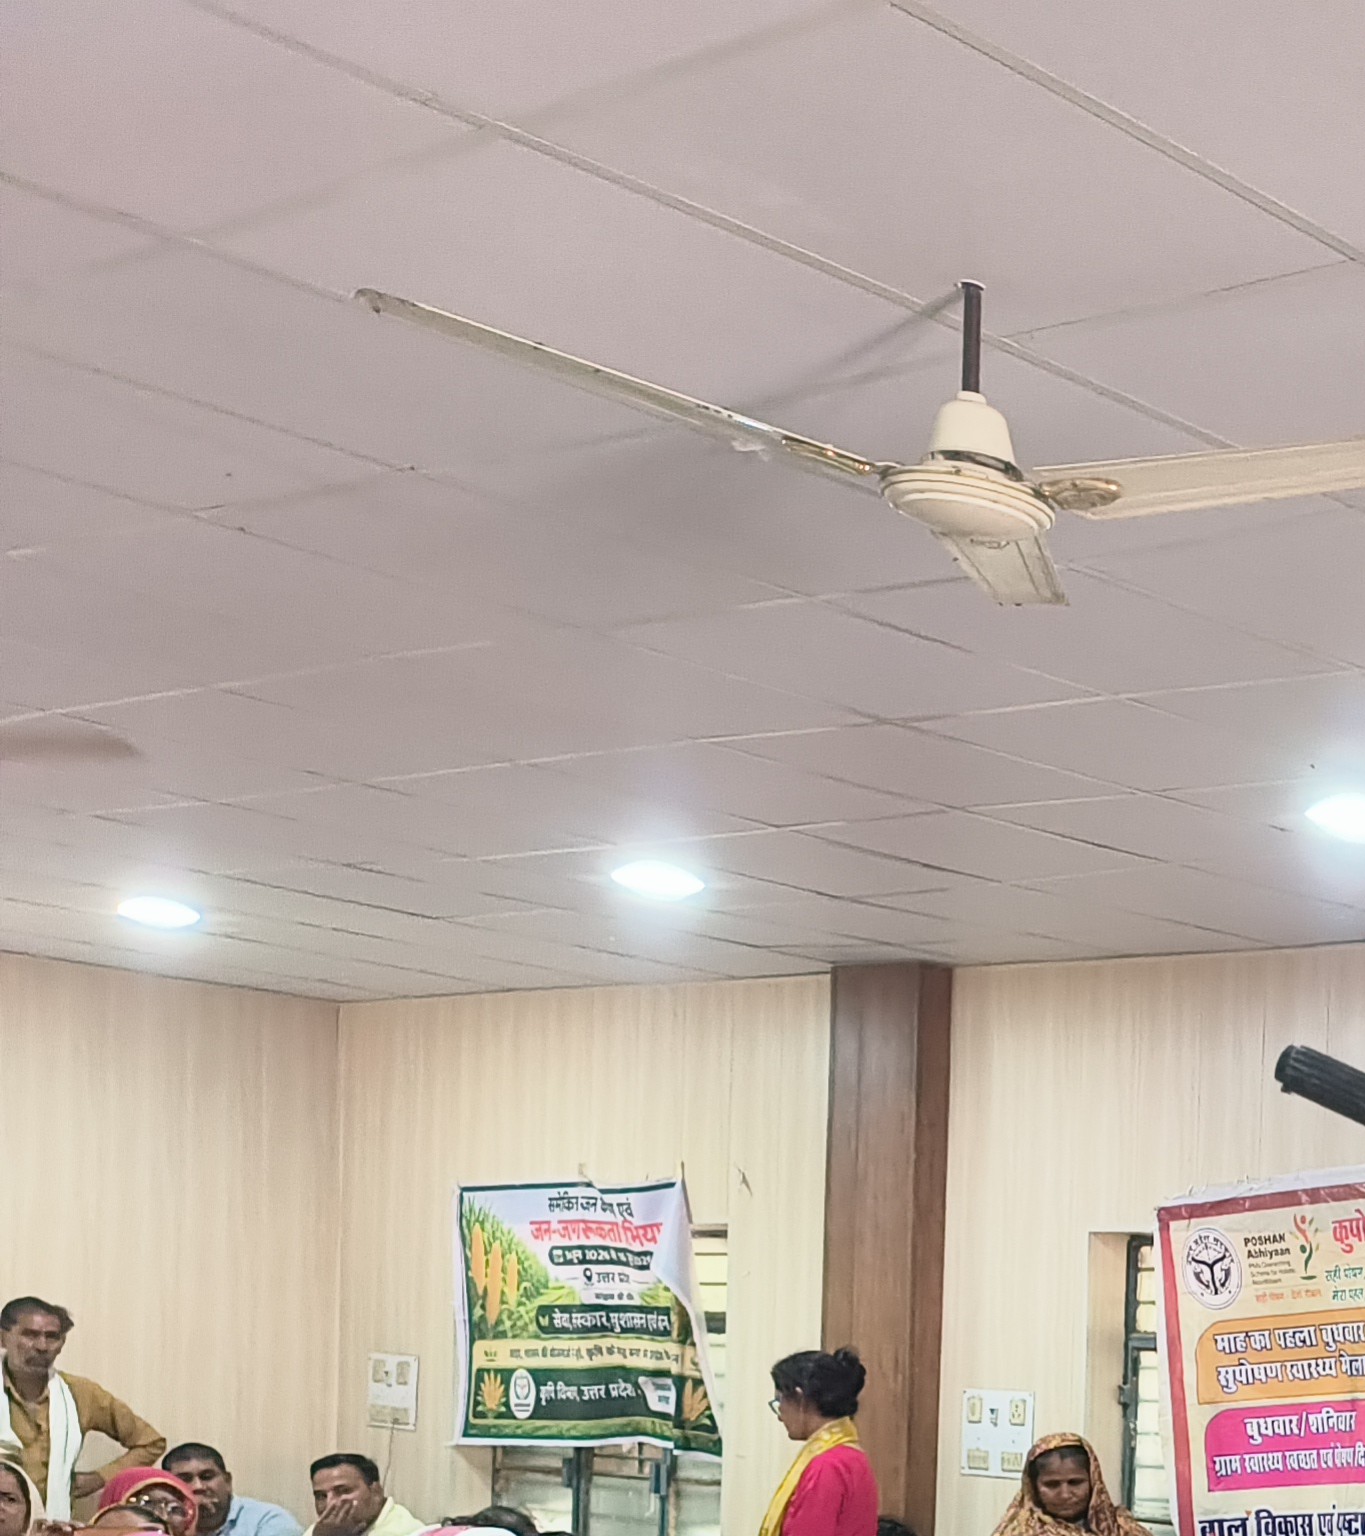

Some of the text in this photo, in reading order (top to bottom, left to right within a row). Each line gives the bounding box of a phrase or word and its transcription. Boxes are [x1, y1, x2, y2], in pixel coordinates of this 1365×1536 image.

[1243, 1232, 1286, 1248] POSHAN
[1246, 1245, 1292, 1261] Abhiyaan
[1213, 1332, 1248, 1354] माह
[1248, 1329, 1271, 1351] का
[1273, 1325, 1319, 1349] पहला
[1216, 1358, 1284, 1394] सुपोषण
[1284, 1356, 1338, 1381] स्वास्थ्य
[580, 1383, 606, 1401] उत्तर
[1244, 1406, 1358, 1446] बुधवार/शनिवार
[1213, 1454, 1242, 1478] ग्राम
[1243, 1451, 1284, 1473] स्वास्थ्य
